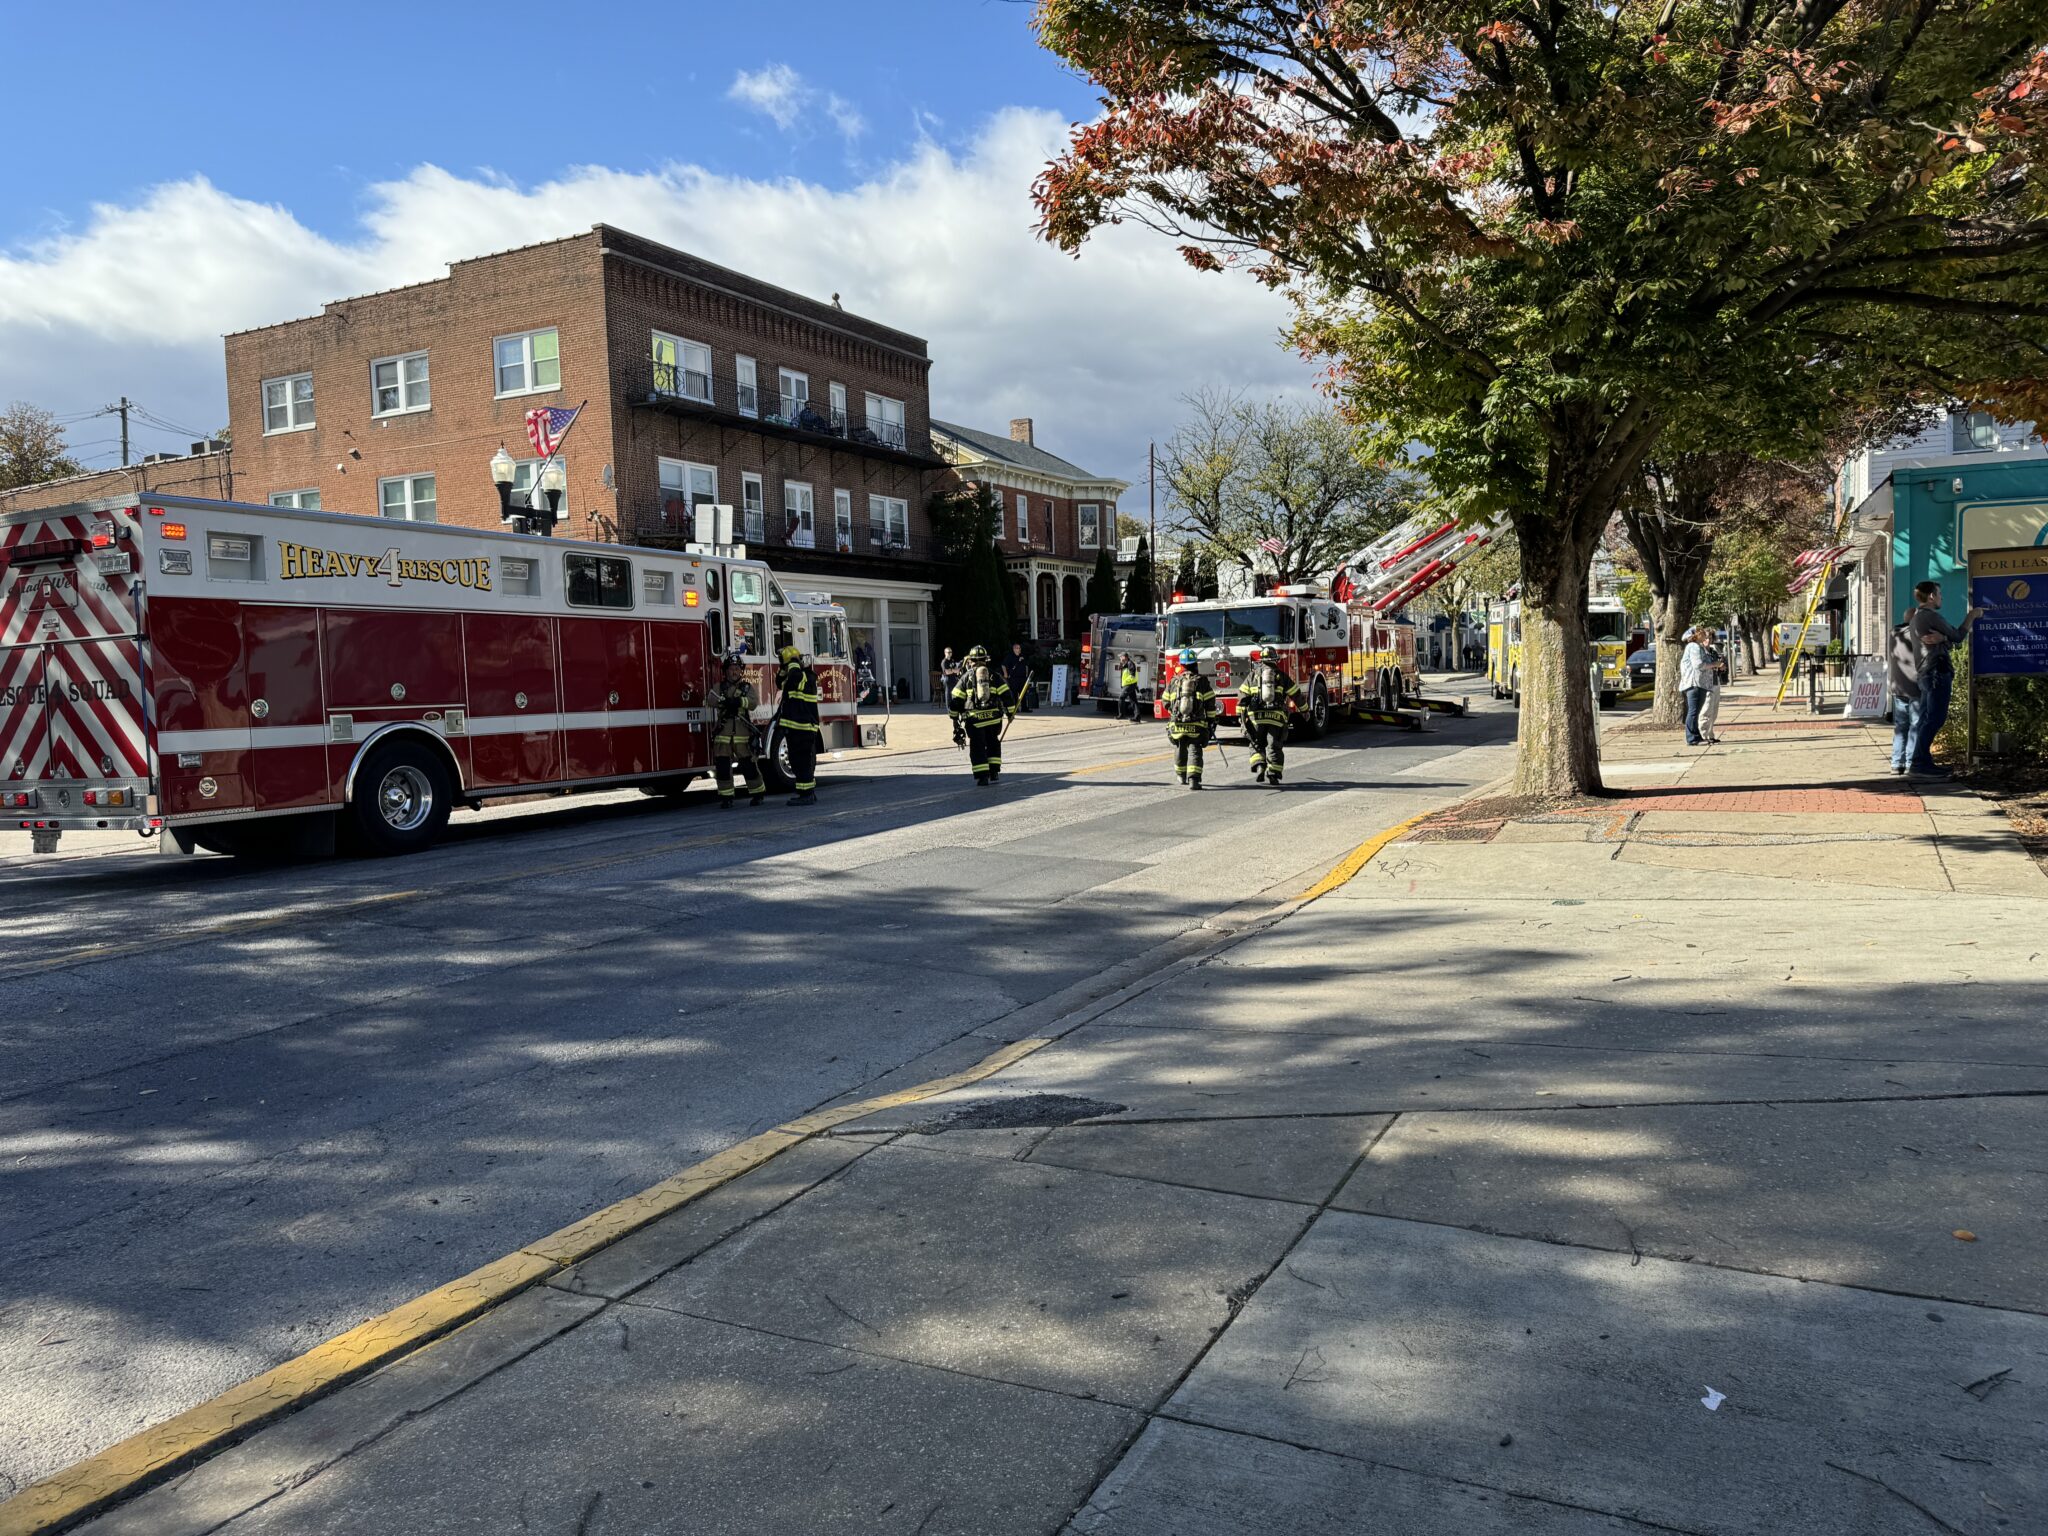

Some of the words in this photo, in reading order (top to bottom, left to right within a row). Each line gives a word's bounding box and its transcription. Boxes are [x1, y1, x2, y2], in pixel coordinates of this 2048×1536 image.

[278, 541, 380, 580] HEAVY
[376, 548, 402, 587] 4
[399, 557, 493, 591] RESCUE
[1980, 561, 2008, 570] FOR
[52, 577, 71, 590] We
[1980, 622, 2020, 630] BRADEN
[1215, 661, 1231, 688] 3
[69, 679, 131, 702] SQUAD
[1857, 683, 1882, 696] NOW
[1853, 696, 1880, 710] OPEN
[686, 710, 700, 721] RIT
